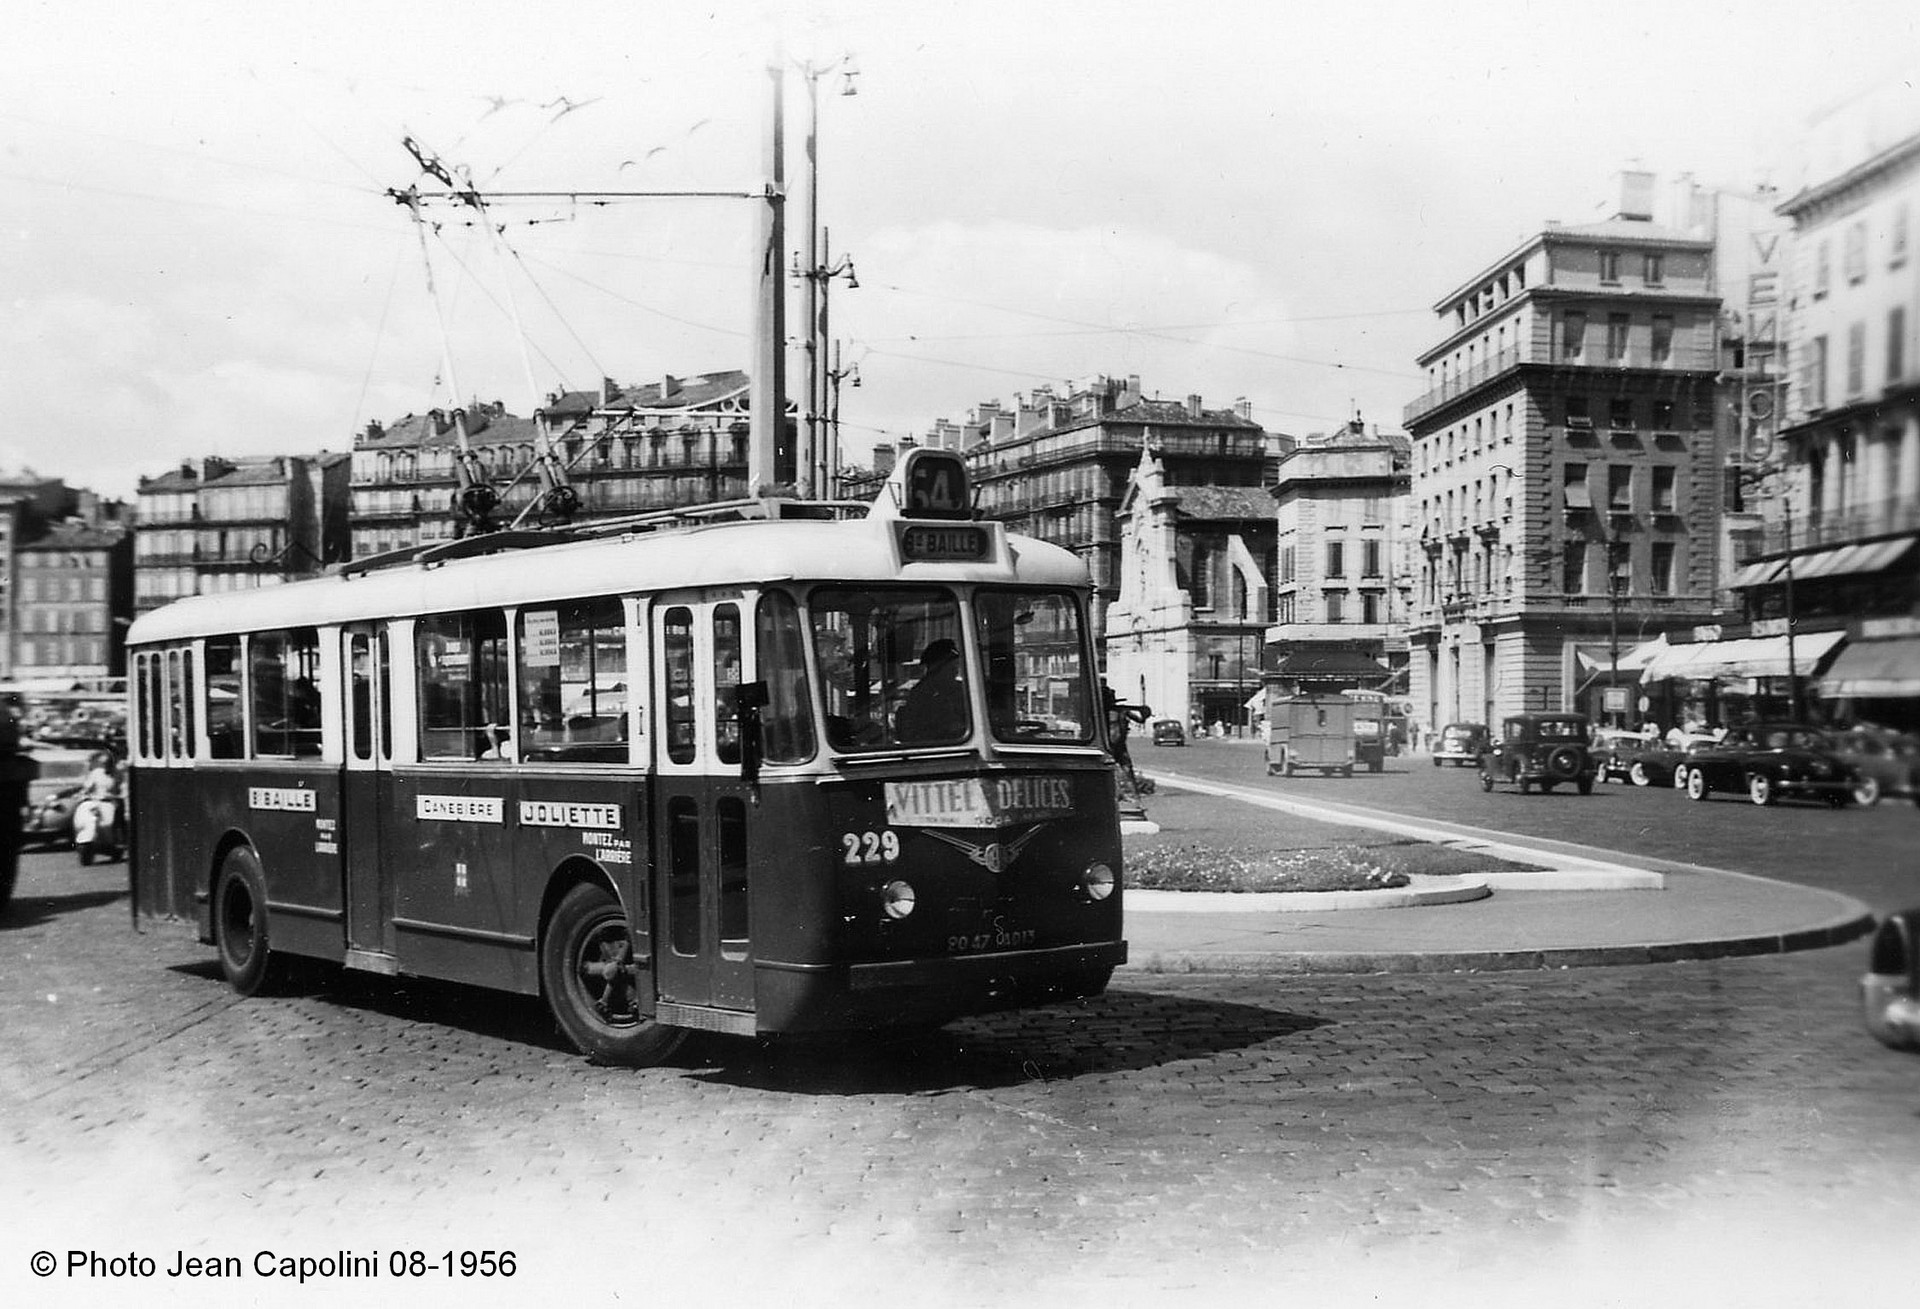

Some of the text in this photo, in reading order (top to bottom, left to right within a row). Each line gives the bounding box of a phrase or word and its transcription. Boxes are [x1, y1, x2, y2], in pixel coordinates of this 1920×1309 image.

[927, 534, 976, 553] BAILLE
[264, 791, 311, 808] BAILLE
[894, 778, 1071, 815] VITTEL DELICES
[523, 804, 616, 825] JOLIETTE
[582, 831, 632, 849] MONTEZ PAR
[842, 830, 900, 864] 229
